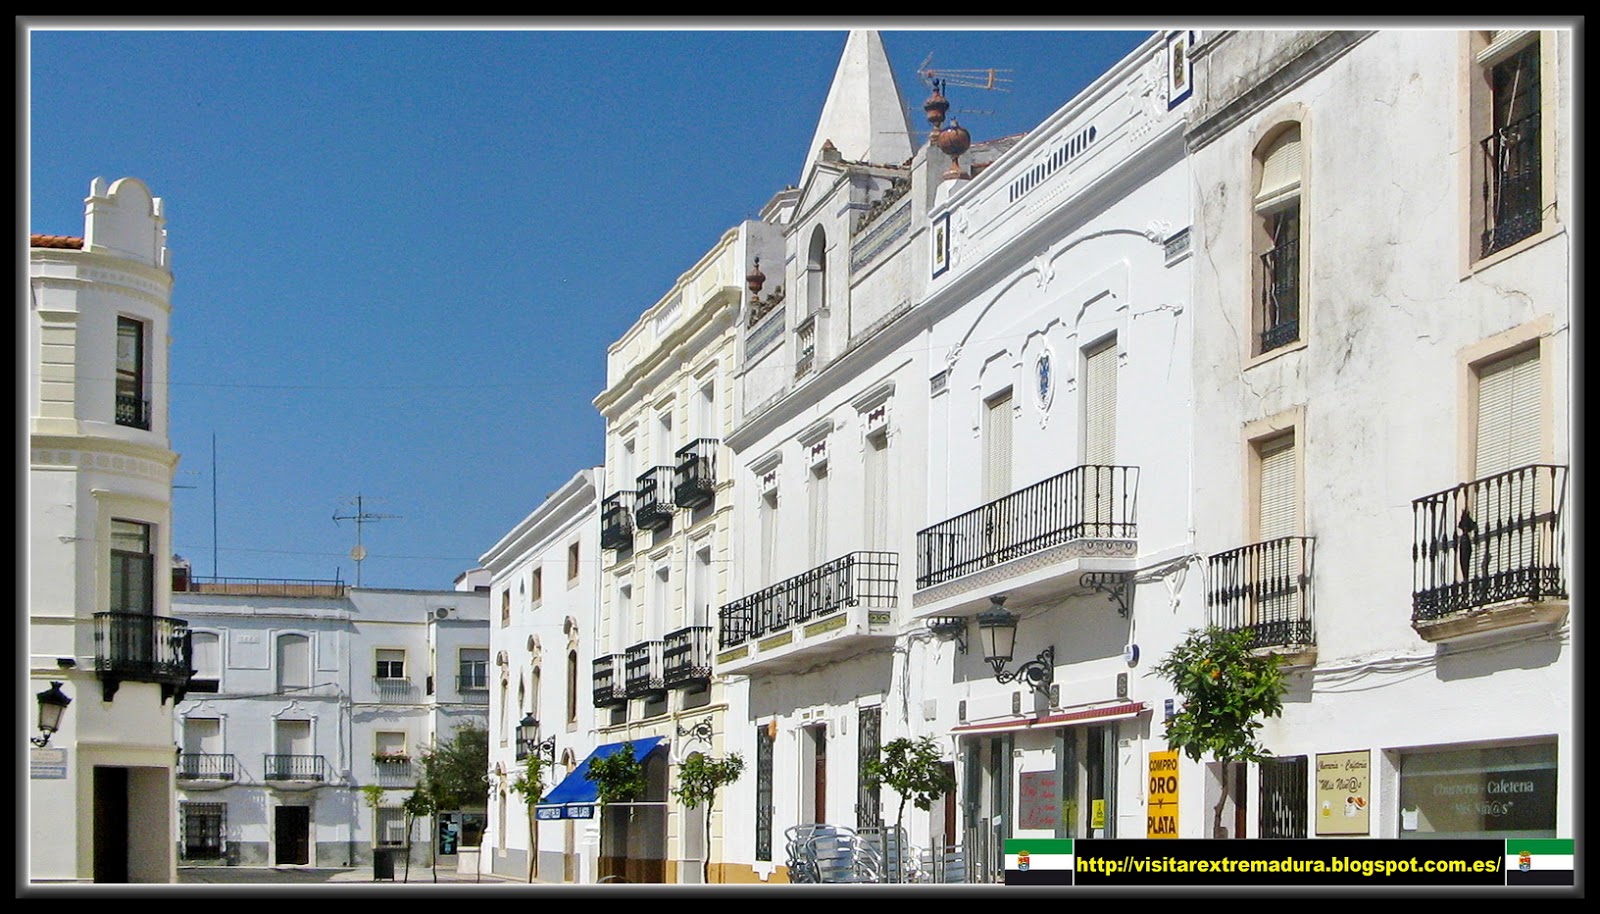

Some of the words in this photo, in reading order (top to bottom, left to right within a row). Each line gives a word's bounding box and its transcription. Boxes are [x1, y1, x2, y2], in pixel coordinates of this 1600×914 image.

[1149, 758, 1178, 772] COMPRO
[1149, 775, 1178, 795] ORO
[1147, 816, 1176, 834] PLATA
